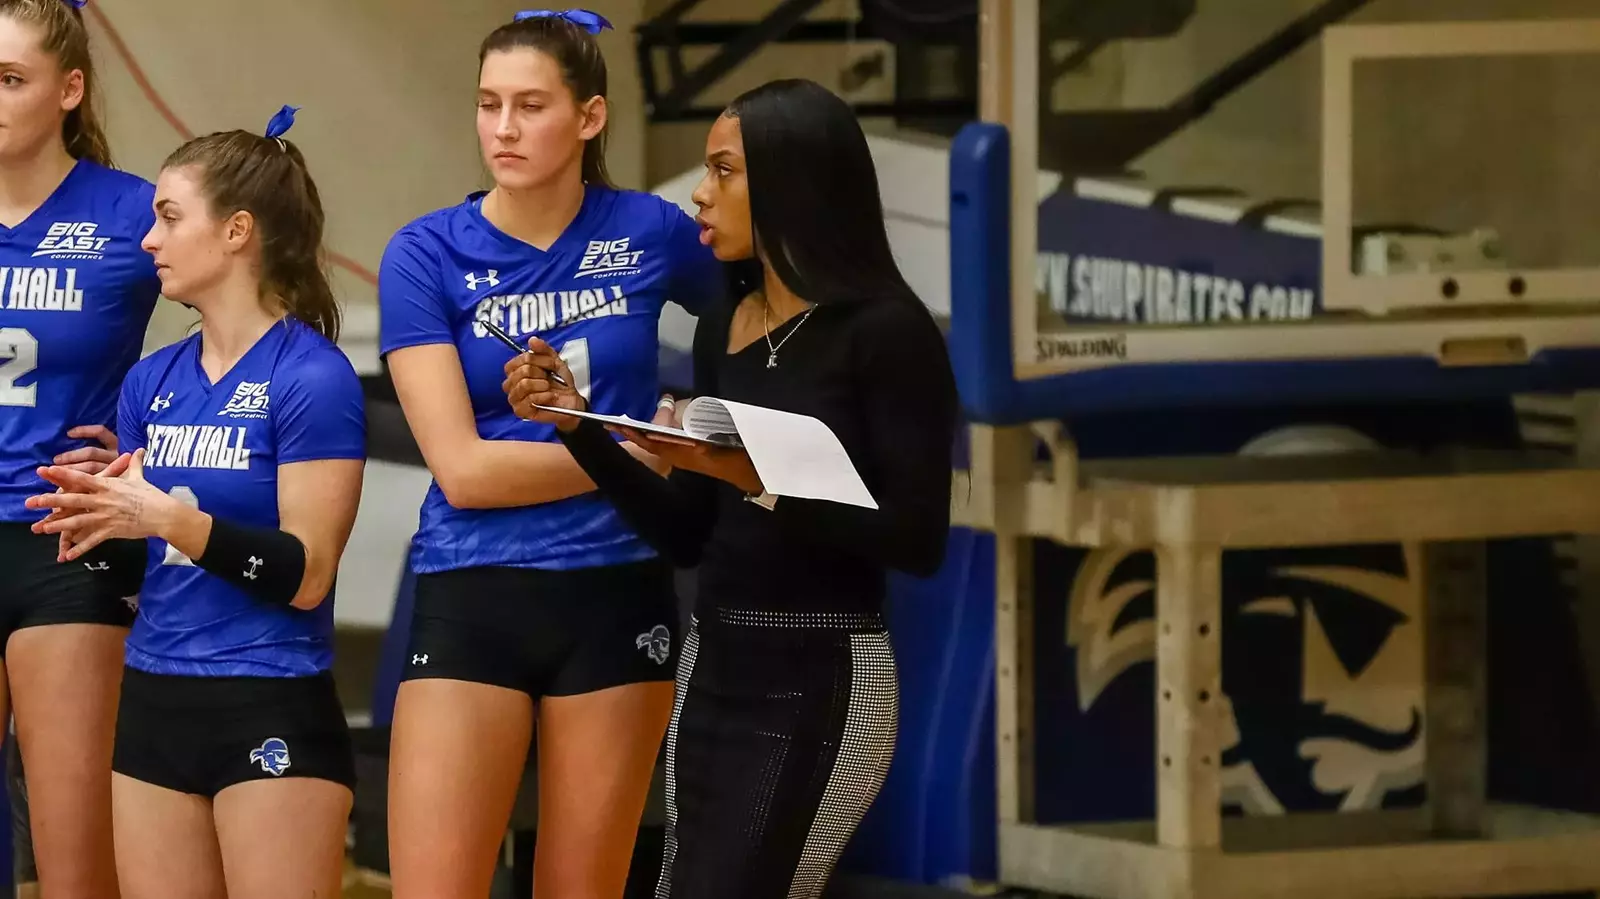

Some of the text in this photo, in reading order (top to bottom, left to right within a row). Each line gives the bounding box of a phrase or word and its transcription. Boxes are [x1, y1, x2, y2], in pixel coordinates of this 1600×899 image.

[46, 222, 98, 236] BIG
[37, 236, 111, 250] EAST
[585, 237, 630, 255] BIG
[578, 250, 644, 270] EAST
[593, 269, 642, 279] CONFERENCE
[8, 267, 84, 312] HALL
[472, 285, 628, 339] SETON HALL
[1036, 335, 1127, 361] SPALDING
[235, 381, 270, 397] BIG
[225, 394, 269, 409] EAST
[190, 425, 251, 470] HALL
